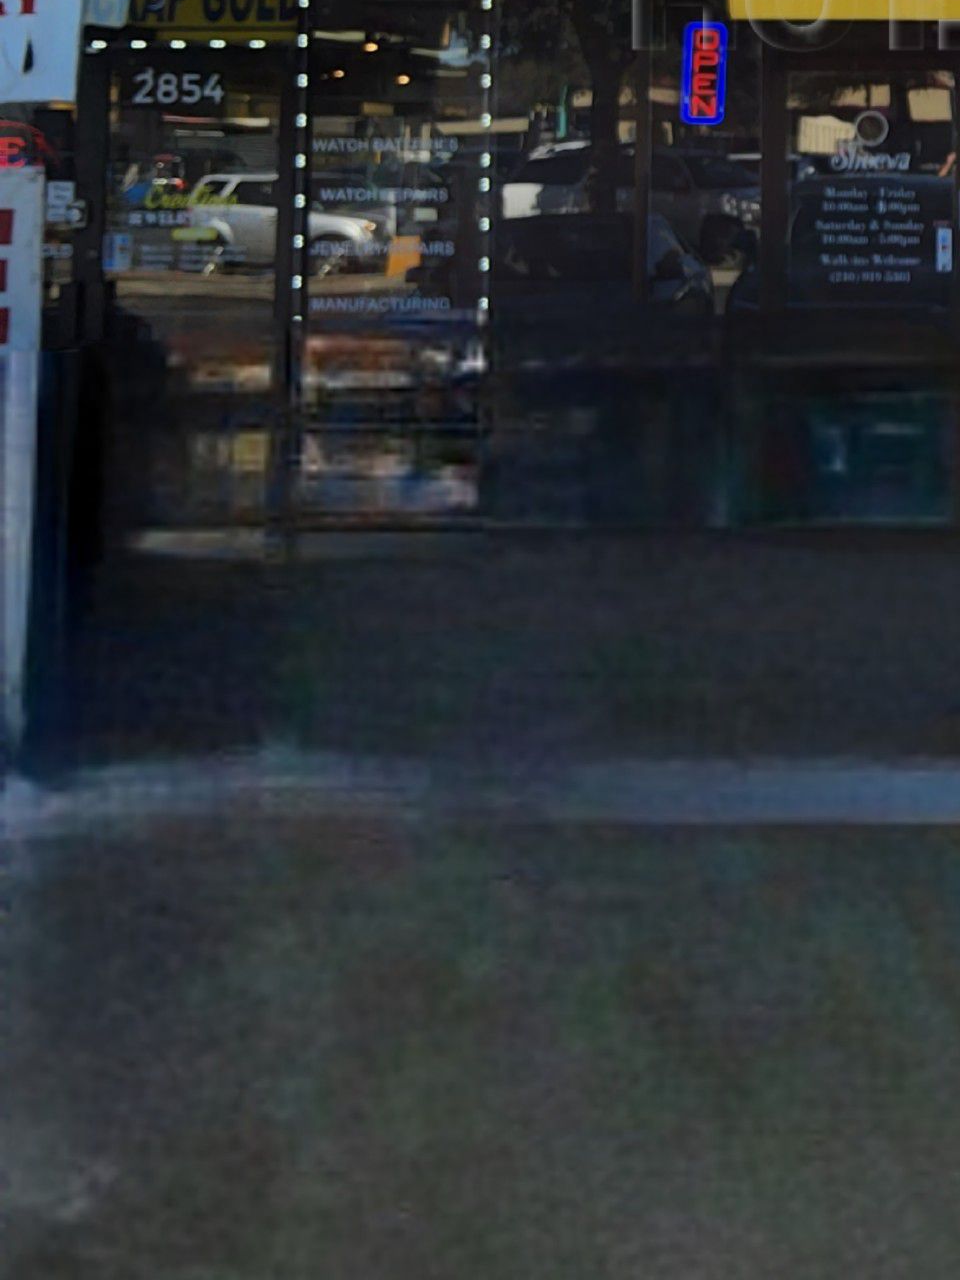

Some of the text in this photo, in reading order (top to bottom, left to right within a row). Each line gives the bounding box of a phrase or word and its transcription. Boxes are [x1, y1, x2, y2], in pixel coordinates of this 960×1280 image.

[691, 29, 720, 117] OPEN
[132, 71, 224, 104] 2854
[312, 138, 369, 152] WATCH
[320, 188, 377, 201] WATCH
[311, 297, 451, 311] MANUFACTURING
